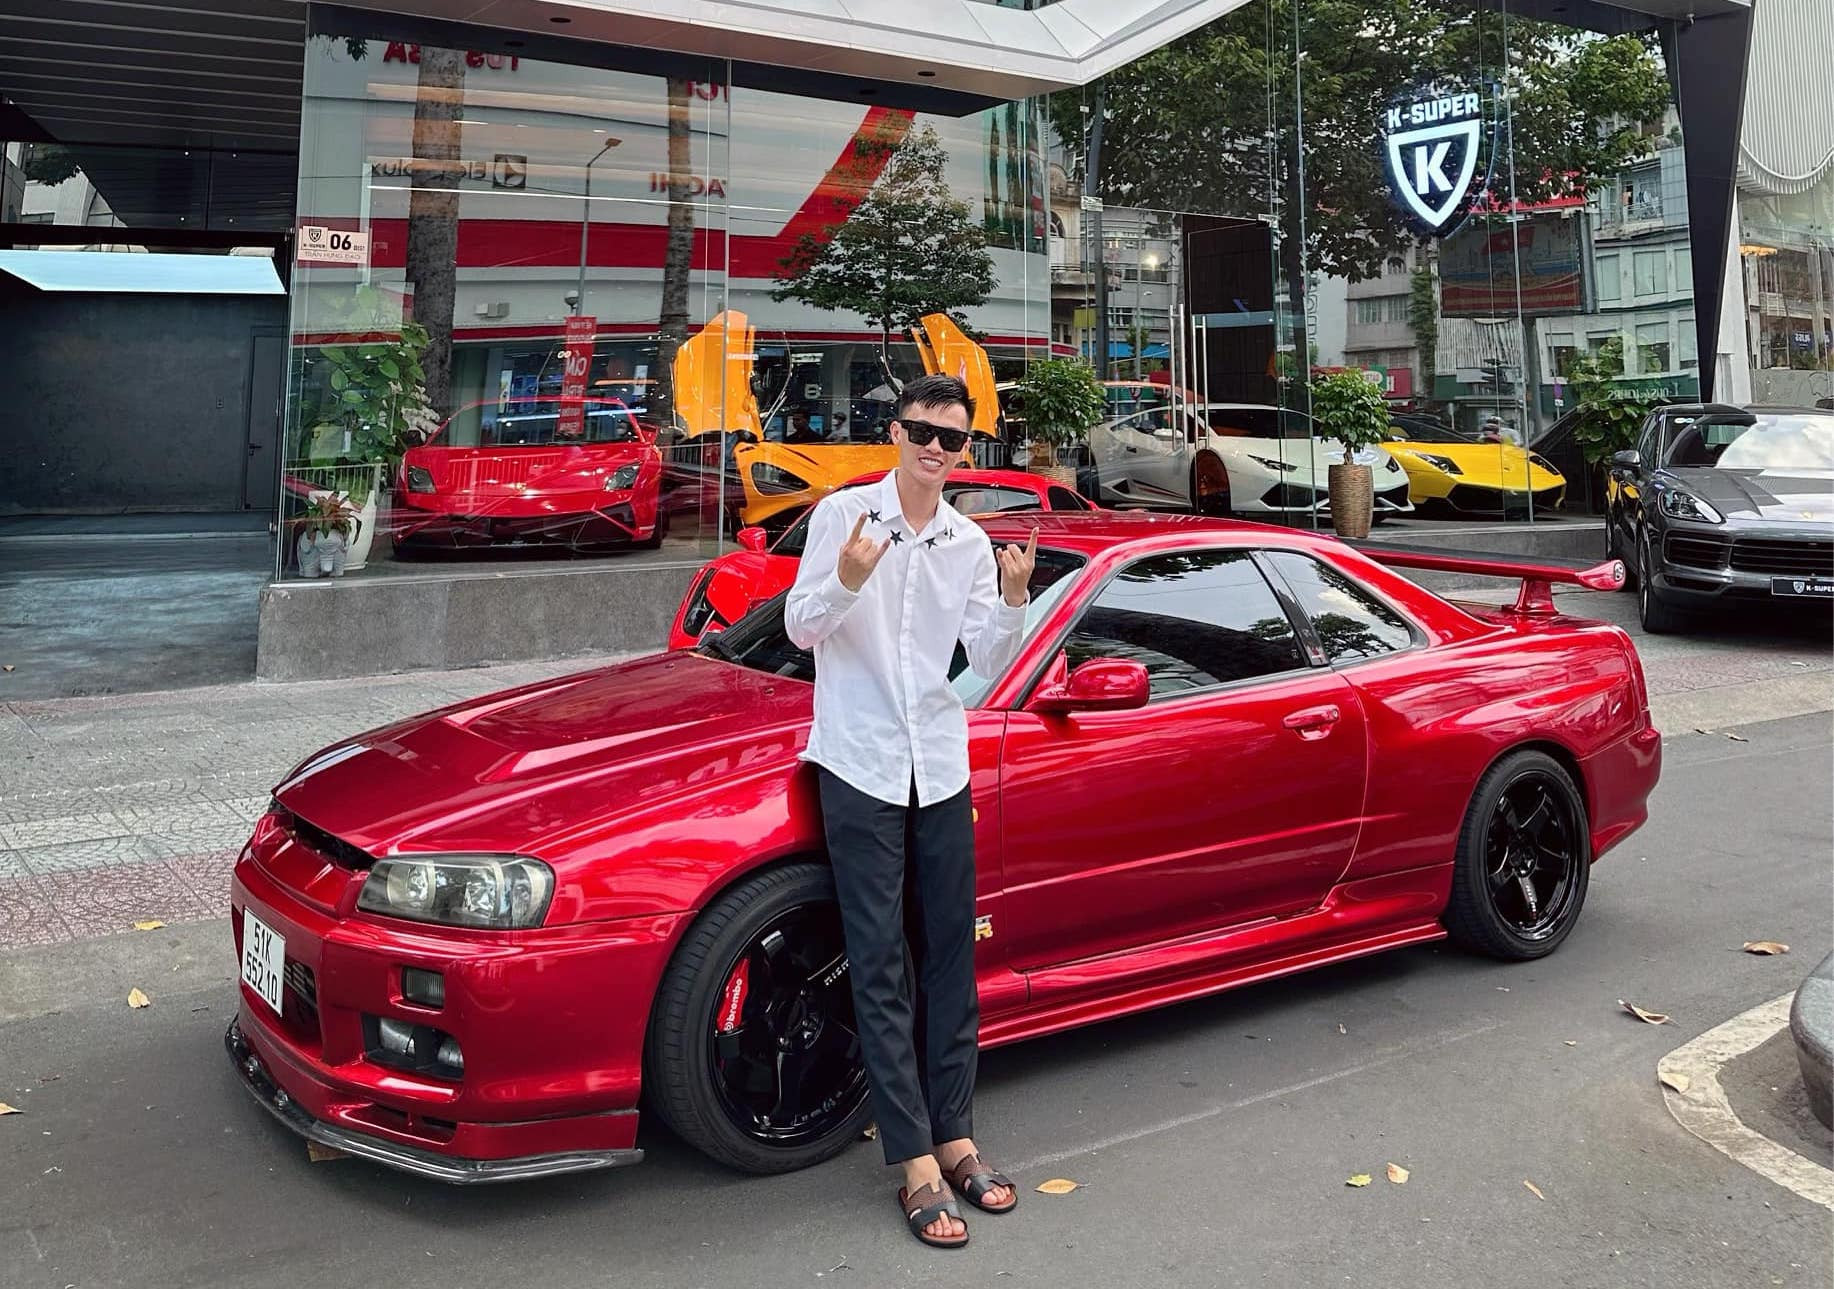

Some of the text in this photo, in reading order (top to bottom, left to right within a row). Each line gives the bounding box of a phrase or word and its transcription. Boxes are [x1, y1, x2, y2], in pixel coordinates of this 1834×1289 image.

[1387, 92, 1480, 129] K-SUPER
[1415, 141, 1454, 195] K
[330, 233, 352, 251] 06
[254, 922, 273, 962] 51K
[245, 955, 278, 1005] 552.10
[726, 978, 743, 1022] brembo
